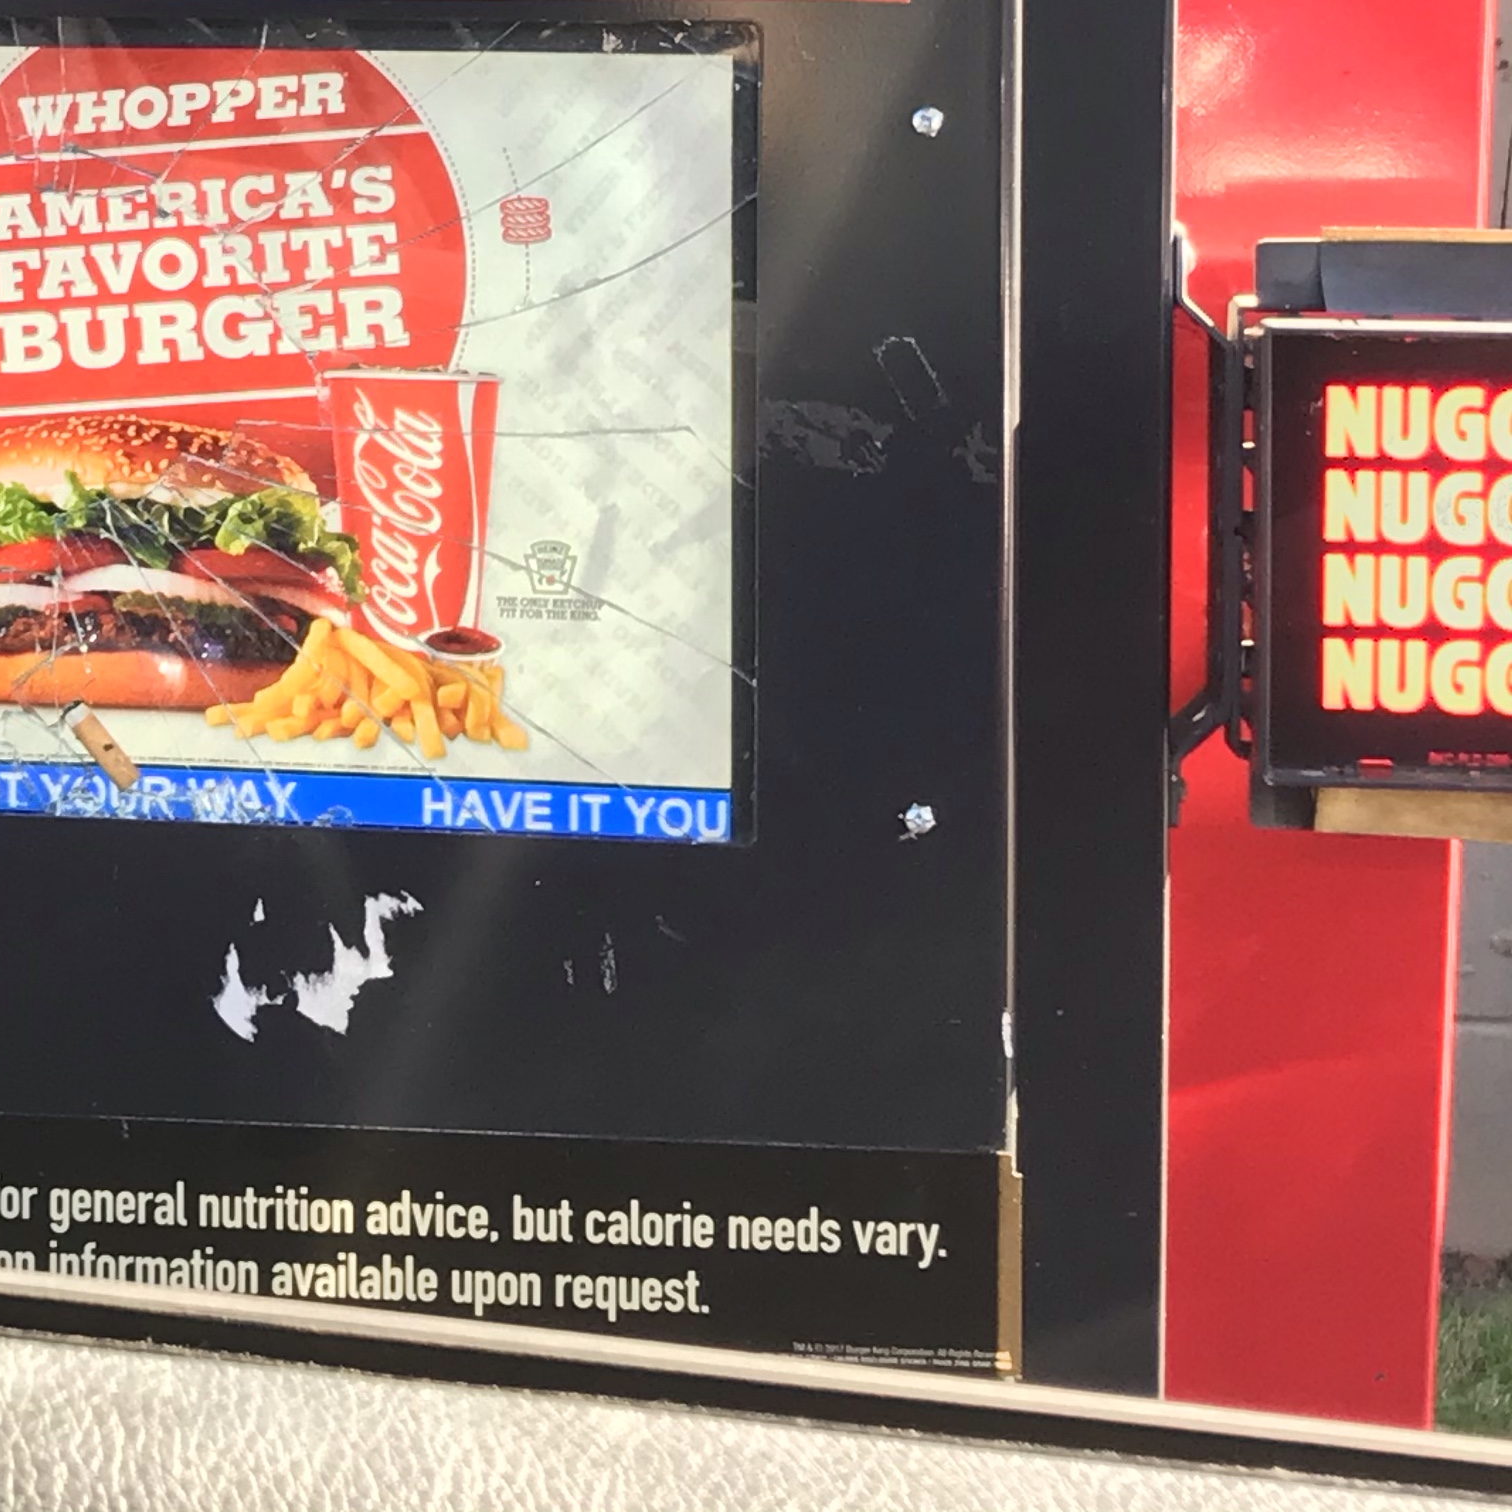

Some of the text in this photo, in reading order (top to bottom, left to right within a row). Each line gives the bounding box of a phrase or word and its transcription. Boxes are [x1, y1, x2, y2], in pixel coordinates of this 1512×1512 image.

[18, 72, 346, 141] WHOPPER
[496, 596, 518, 607] THE
[520, 597, 549, 608] ONLY
[520, 609, 543, 619] FOR
[545, 609, 567, 620] THE
[40, 773, 175, 819] YOUR
[190, 776, 299, 823] WAY
[422, 787, 728, 838] HAVE IT YOU
[49, 1179, 190, 1234] general
[198, 1184, 354, 1234] nutrition
[366, 1189, 499, 1243] advice,
[513, 1193, 574, 1243] but
[585, 1198, 716, 1250] calorie
[727, 1205, 842, 1255] needs
[852, 1218, 948, 1269] vary.
[49, 1239, 259, 1295] information
[271, 1251, 438, 1303] available
[450, 1267, 542, 1316] upon
[553, 1267, 711, 1322] request.
